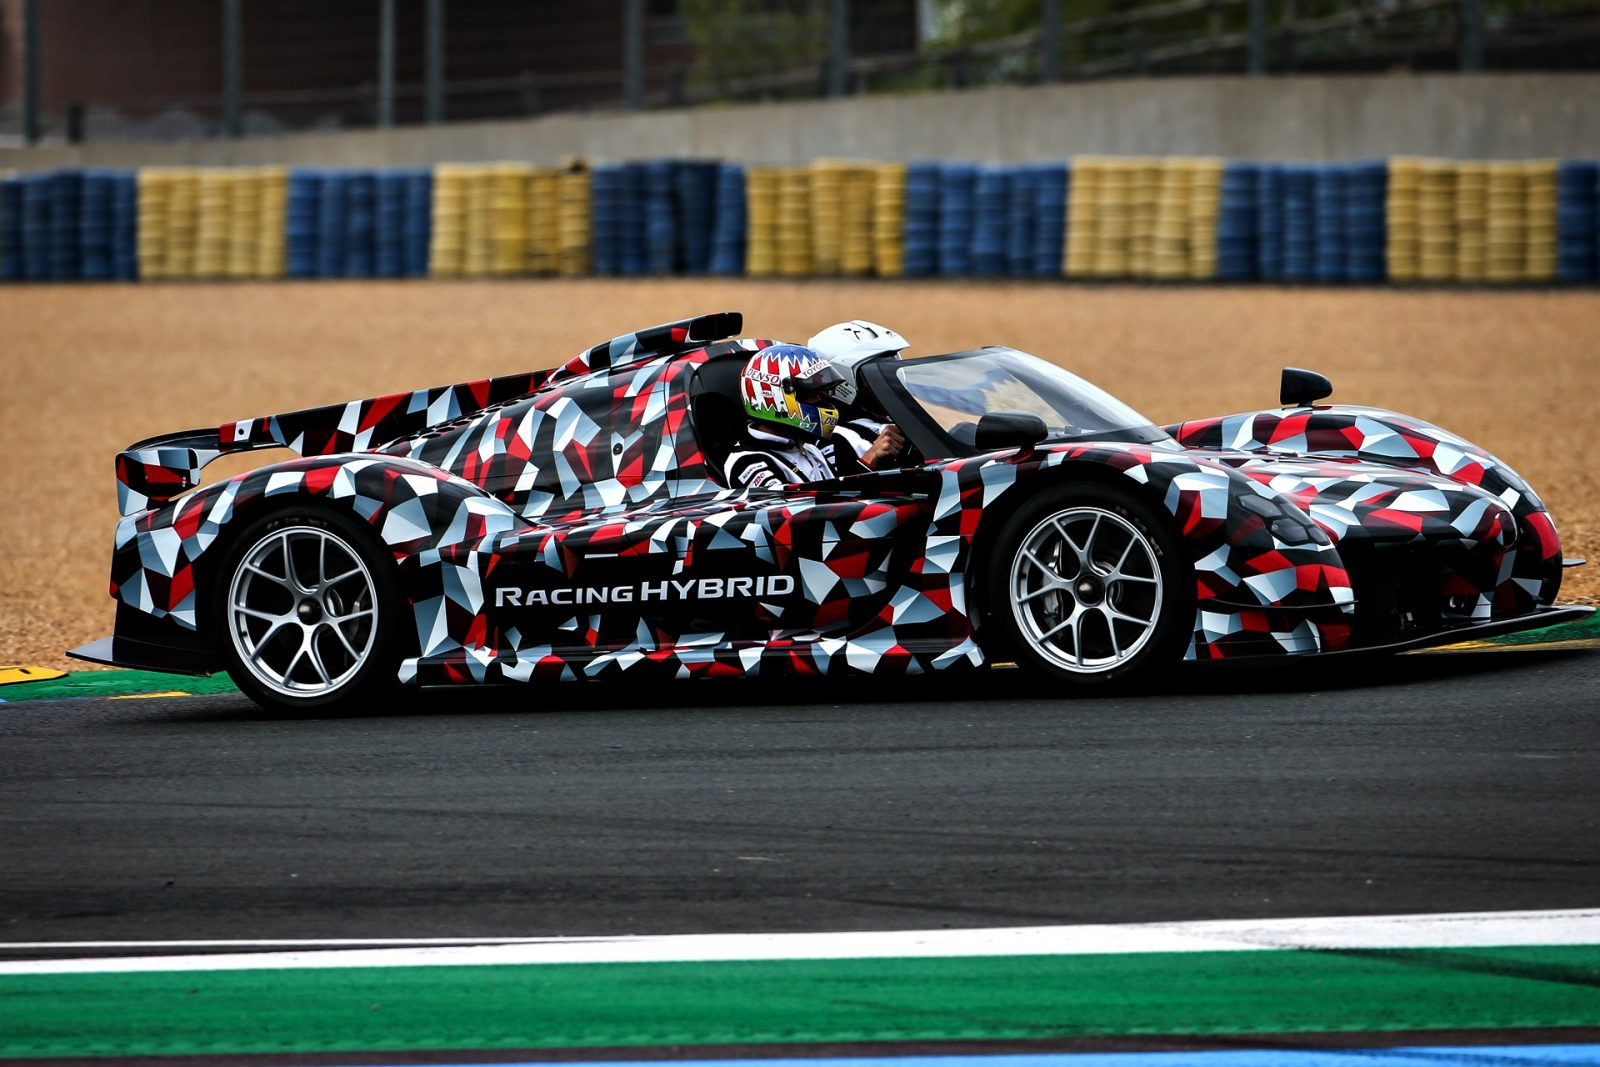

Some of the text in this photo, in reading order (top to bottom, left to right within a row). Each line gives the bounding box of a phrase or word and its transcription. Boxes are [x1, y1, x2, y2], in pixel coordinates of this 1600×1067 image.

[746, 368, 780, 384] DENSO
[802, 361, 828, 377] TOYOTA
[494, 575, 796, 608] RACING HYBRID
